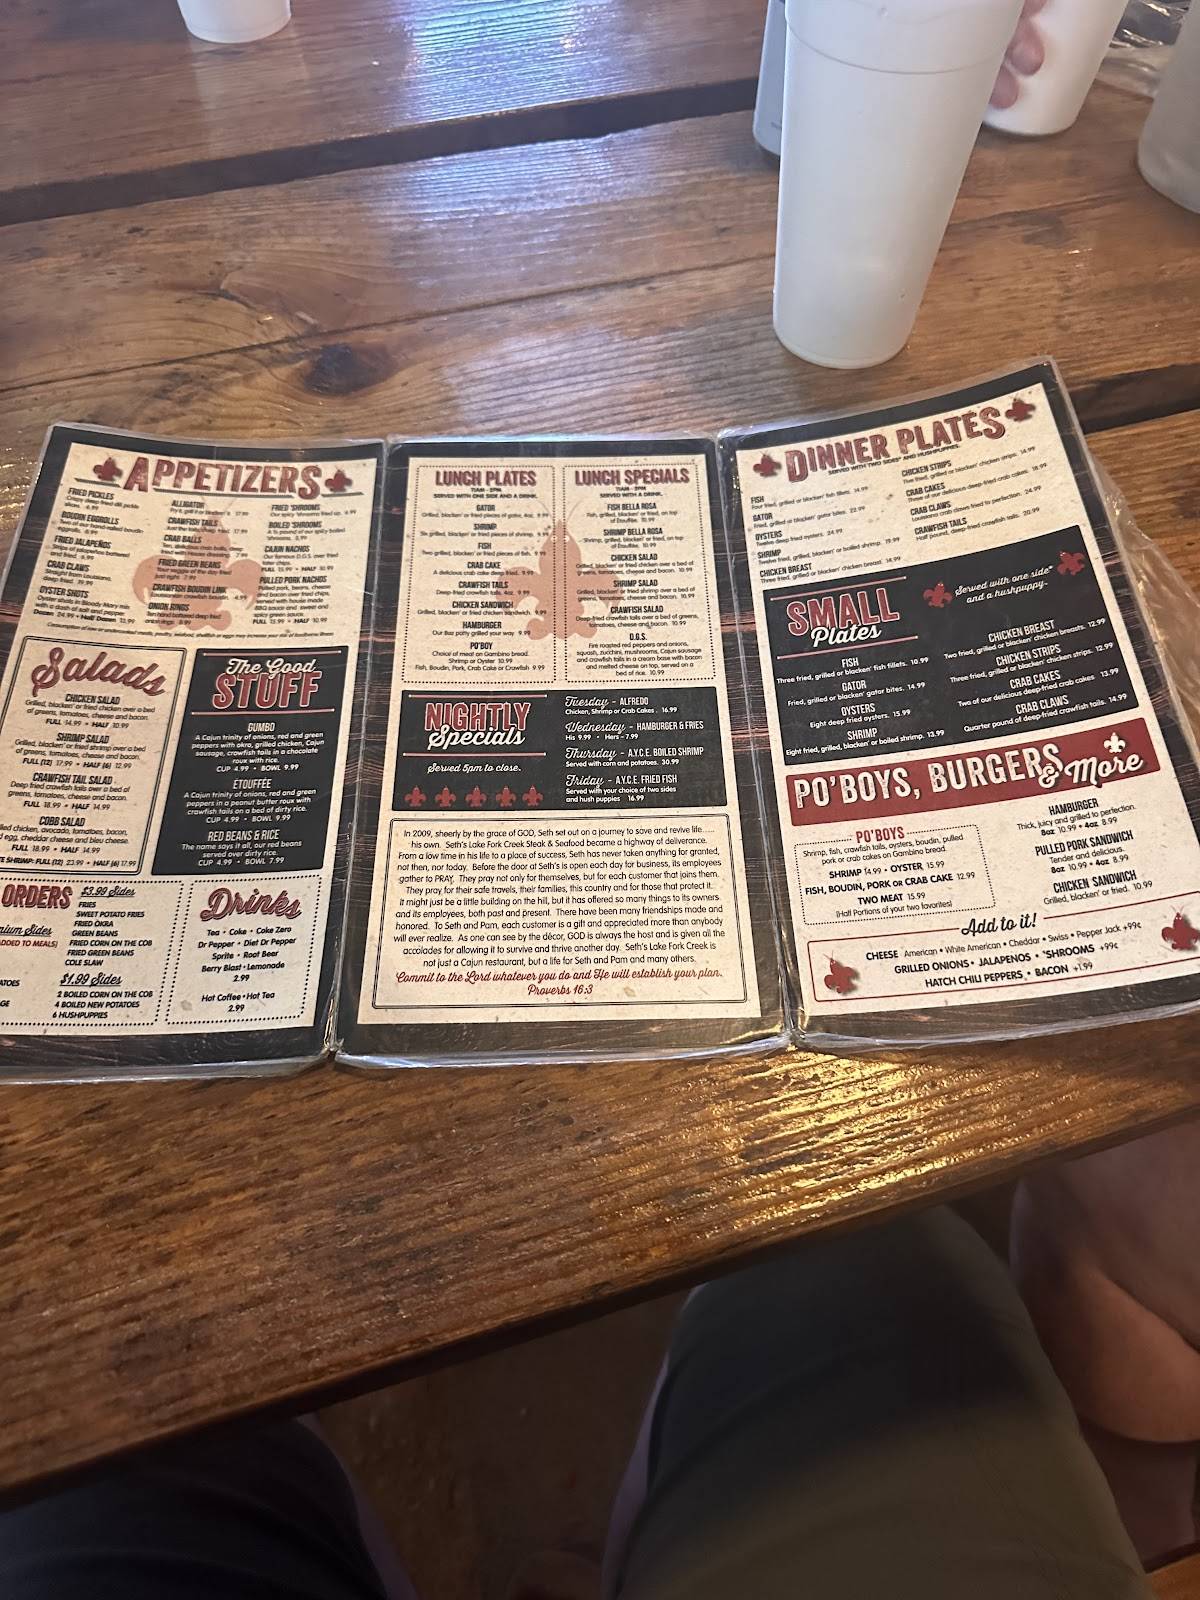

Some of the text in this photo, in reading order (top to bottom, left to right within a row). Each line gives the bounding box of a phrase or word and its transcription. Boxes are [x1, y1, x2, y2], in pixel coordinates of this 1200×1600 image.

[785, 406, 1006, 482] DINNER PLATES
[902, 460, 952, 477] CHICKEN STRIPS
[122, 457, 322, 500] APPETIZERS
[435, 470, 537, 486] LUNCH PLATES
[575, 468, 690, 485] LUNCH SPECIALS
[476, 504, 495, 512] GATOR
[641, 502, 656, 510] ROSA
[753, 512, 773, 522] GATOR
[474, 523, 497, 531] SHRIMP
[914, 517, 967, 535] CRAWFISH TAILS
[755, 530, 782, 541] OYSTERS
[478, 542, 491, 550] FISH
[467, 561, 500, 569] CRAB CAKE
[954, 581, 988, 598] Served
[989, 576, 1009, 588] with
[1011, 573, 1027, 582] one
[786, 588, 900, 636] SMALL
[462, 621, 502, 629] HAMBURGER
[988, 620, 1055, 642] CHICKEN BREAST
[810, 625, 882, 648] Plates
[226, 658, 316, 679] The Good
[842, 657, 859, 667] FISH
[31, 647, 166, 697] Salads
[212, 672, 322, 709] STUFF
[842, 680, 867, 691] GATOR
[65, 693, 120, 705] CHICKEN SALAD
[565, 695, 649, 709] Tuesday ALFREDO
[1015, 695, 1069, 715] CRAB CLAWS
[424, 702, 531, 731] NIGHTLY
[841, 703, 876, 716] OYSTERS
[248, 722, 275, 732] GUMBO
[565, 720, 704, 735] Wednesday HAMBURGER & FRIES
[57, 733, 109, 744] SHRIMP SALAD
[428, 725, 526, 750] Specials
[565, 747, 617, 761] Thursday
[653, 747, 676, 756] BOILED
[678, 746, 704, 756] SHRIMP
[428, 762, 522, 774] Served 5pm to close.
[927, 743, 1065, 793] BURGERS
[1037, 751, 1144, 789] & More
[32, 773, 112, 785] CRAWFISH TAIL SALAD
[566, 774, 604, 789] Friday
[641, 774, 660, 784] FRIED
[662, 774, 677, 783] FISH
[1048, 798, 1099, 816] HAMBURGER
[39, 816, 85, 827] COBB SALAD
[252, 815, 273, 823] BOWL
[208, 829, 279, 841] RED BEANS & RICE
[413, 830, 432, 839] 2009,
[435, 830, 460, 838] sheerly
[463, 829, 471, 838] by
[473, 829, 484, 837] the
[1035, 830, 1134, 856] PULLED PORK SANDWICH
[829, 862, 923, 879] SHRIMP OYSTER
[2, 884, 73, 909] ORDERS
[81, 886, 136, 898] $3.99 Sides
[857, 893, 903, 905] TWO MEAT
[199, 887, 302, 921] Drinks
[256, 926, 274, 934] Coke
[275, 925, 291, 933] Zero
[961, 913, 1037, 936] Add to it!
[72, 929, 94, 937] GREEN
[212, 952, 234, 961] Sprite
[262, 950, 278, 958] Beer
[866, 950, 899, 961] CHEESE
[894, 954, 1031, 974] GRILLED ONIONS JALAPENOS
[60, 972, 122, 986] $1.99 Sides
[233, 974, 250, 982] 2.99
[396, 967, 723, 983] Commit to the Lord whatever you do and He will establish your plan.
[925, 964, 1069, 988] HATCH CHILI PEPPERS BACON
[528, 984, 593, 996] Proverbs 16:3
